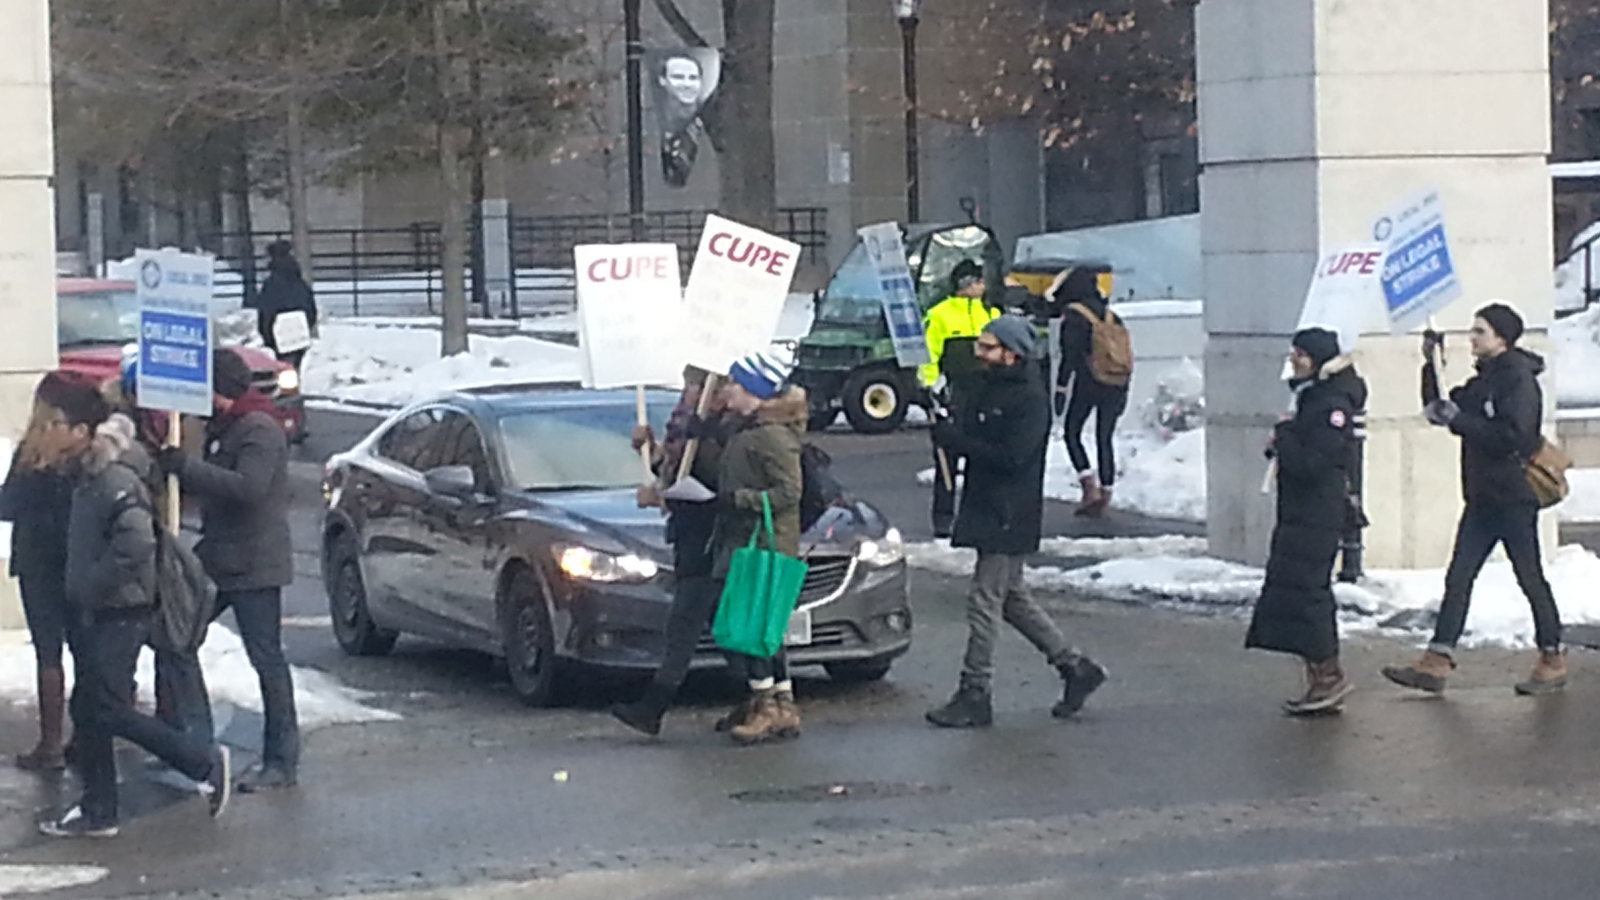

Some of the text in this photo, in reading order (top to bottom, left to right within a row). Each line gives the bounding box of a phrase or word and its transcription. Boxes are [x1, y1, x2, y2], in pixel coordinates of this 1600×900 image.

[708, 231, 791, 276] CUPE
[1403, 232, 1443, 264] LEGAL
[586, 257, 668, 283] CUPE
[1392, 253, 1441, 295] STRIKE
[143, 320, 205, 346] ON LEGAL
[150, 344, 198, 368] STRIKE
